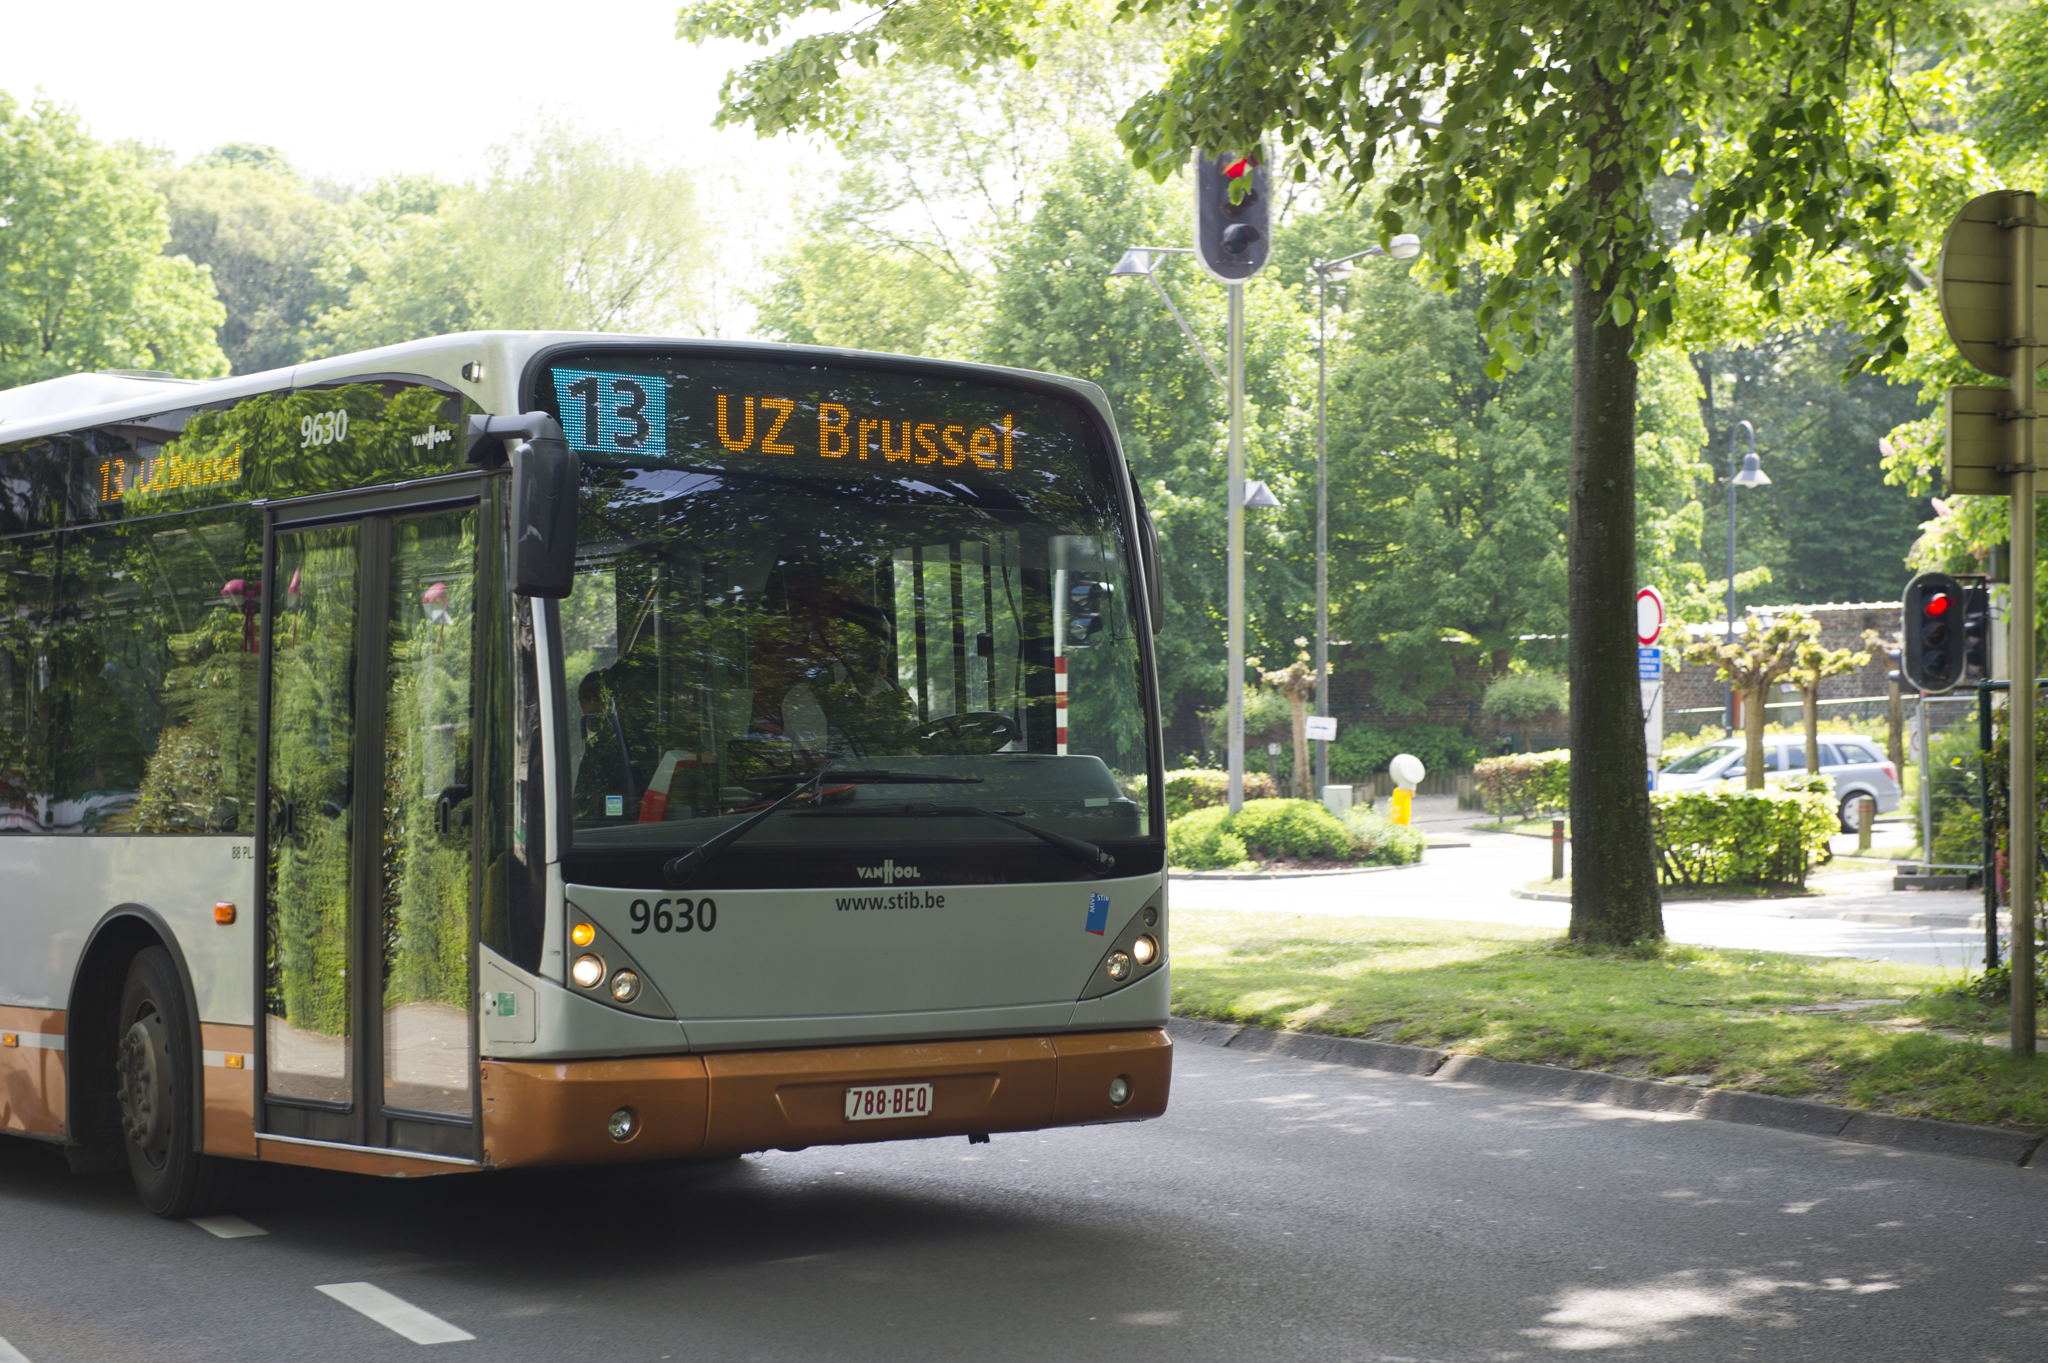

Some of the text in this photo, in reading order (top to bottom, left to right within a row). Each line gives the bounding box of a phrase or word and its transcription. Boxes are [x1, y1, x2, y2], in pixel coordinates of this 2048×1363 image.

[301, 409, 348, 448] 9630
[566, 376, 1014, 470] 13 UZ Brussel
[99, 459, 125, 501] 13
[629, 898, 717, 935] 9630
[836, 891, 945, 911] www.stib.be
